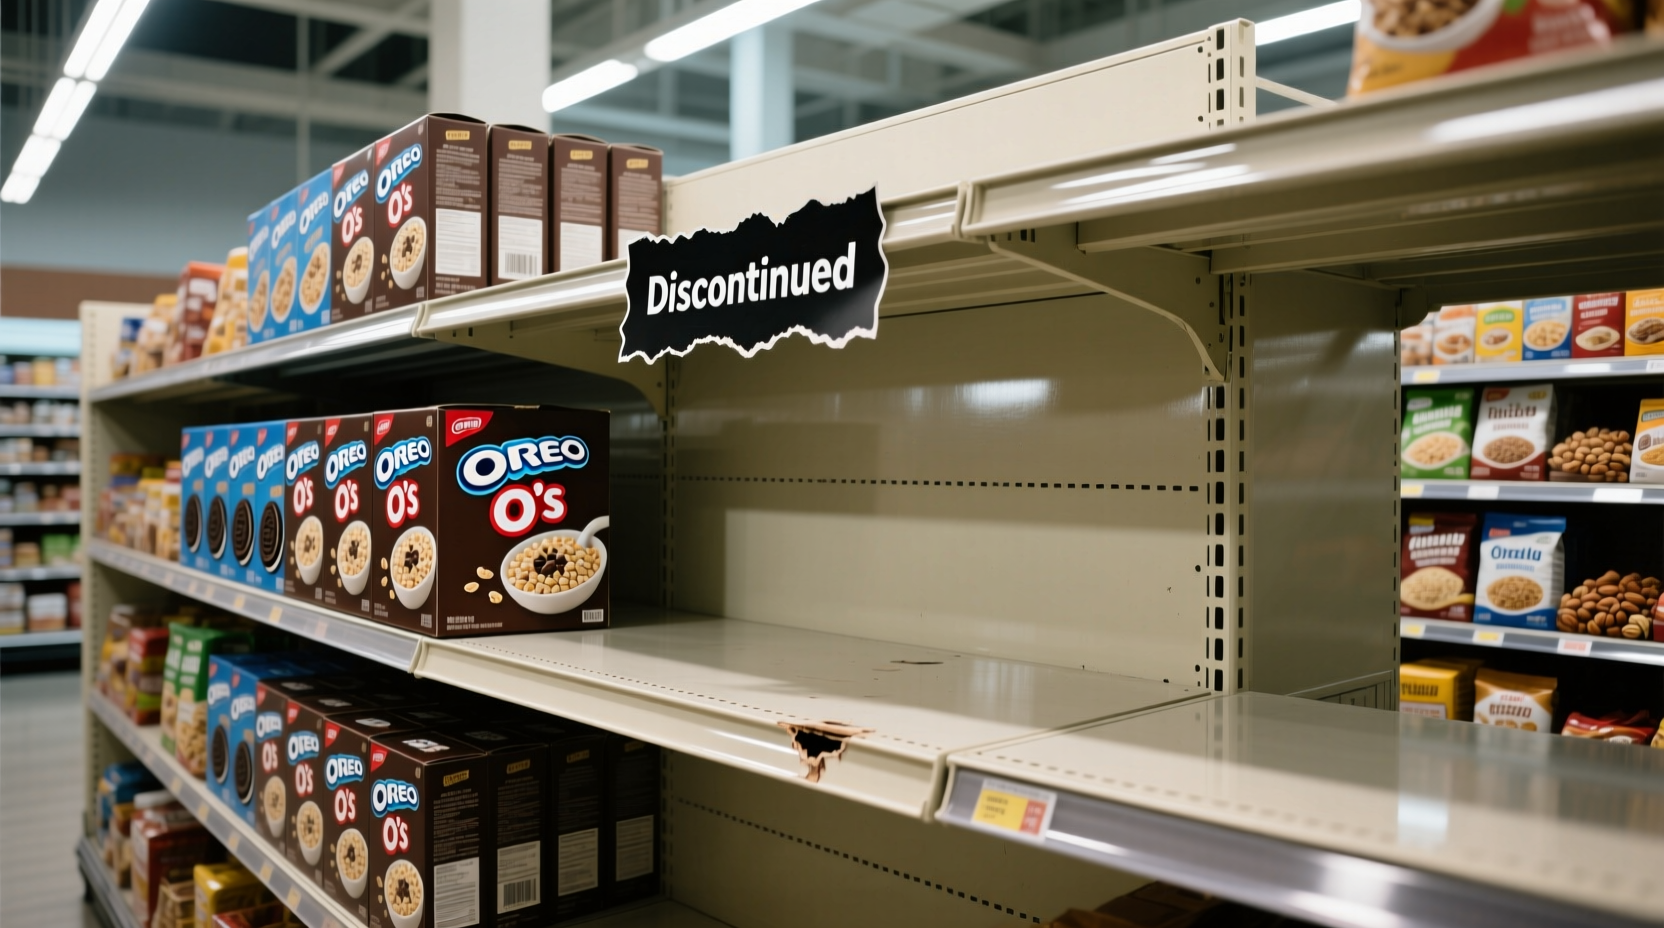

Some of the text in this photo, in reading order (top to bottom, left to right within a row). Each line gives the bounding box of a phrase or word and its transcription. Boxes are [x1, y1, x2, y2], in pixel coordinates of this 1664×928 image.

[647, 241, 856, 315] Discontinued
[326, 444, 367, 482] OREO
[376, 440, 430, 482] OREO
[463, 439, 585, 486] OREO
[326, 758, 363, 784] OREO
[373, 783, 418, 811] OREO
